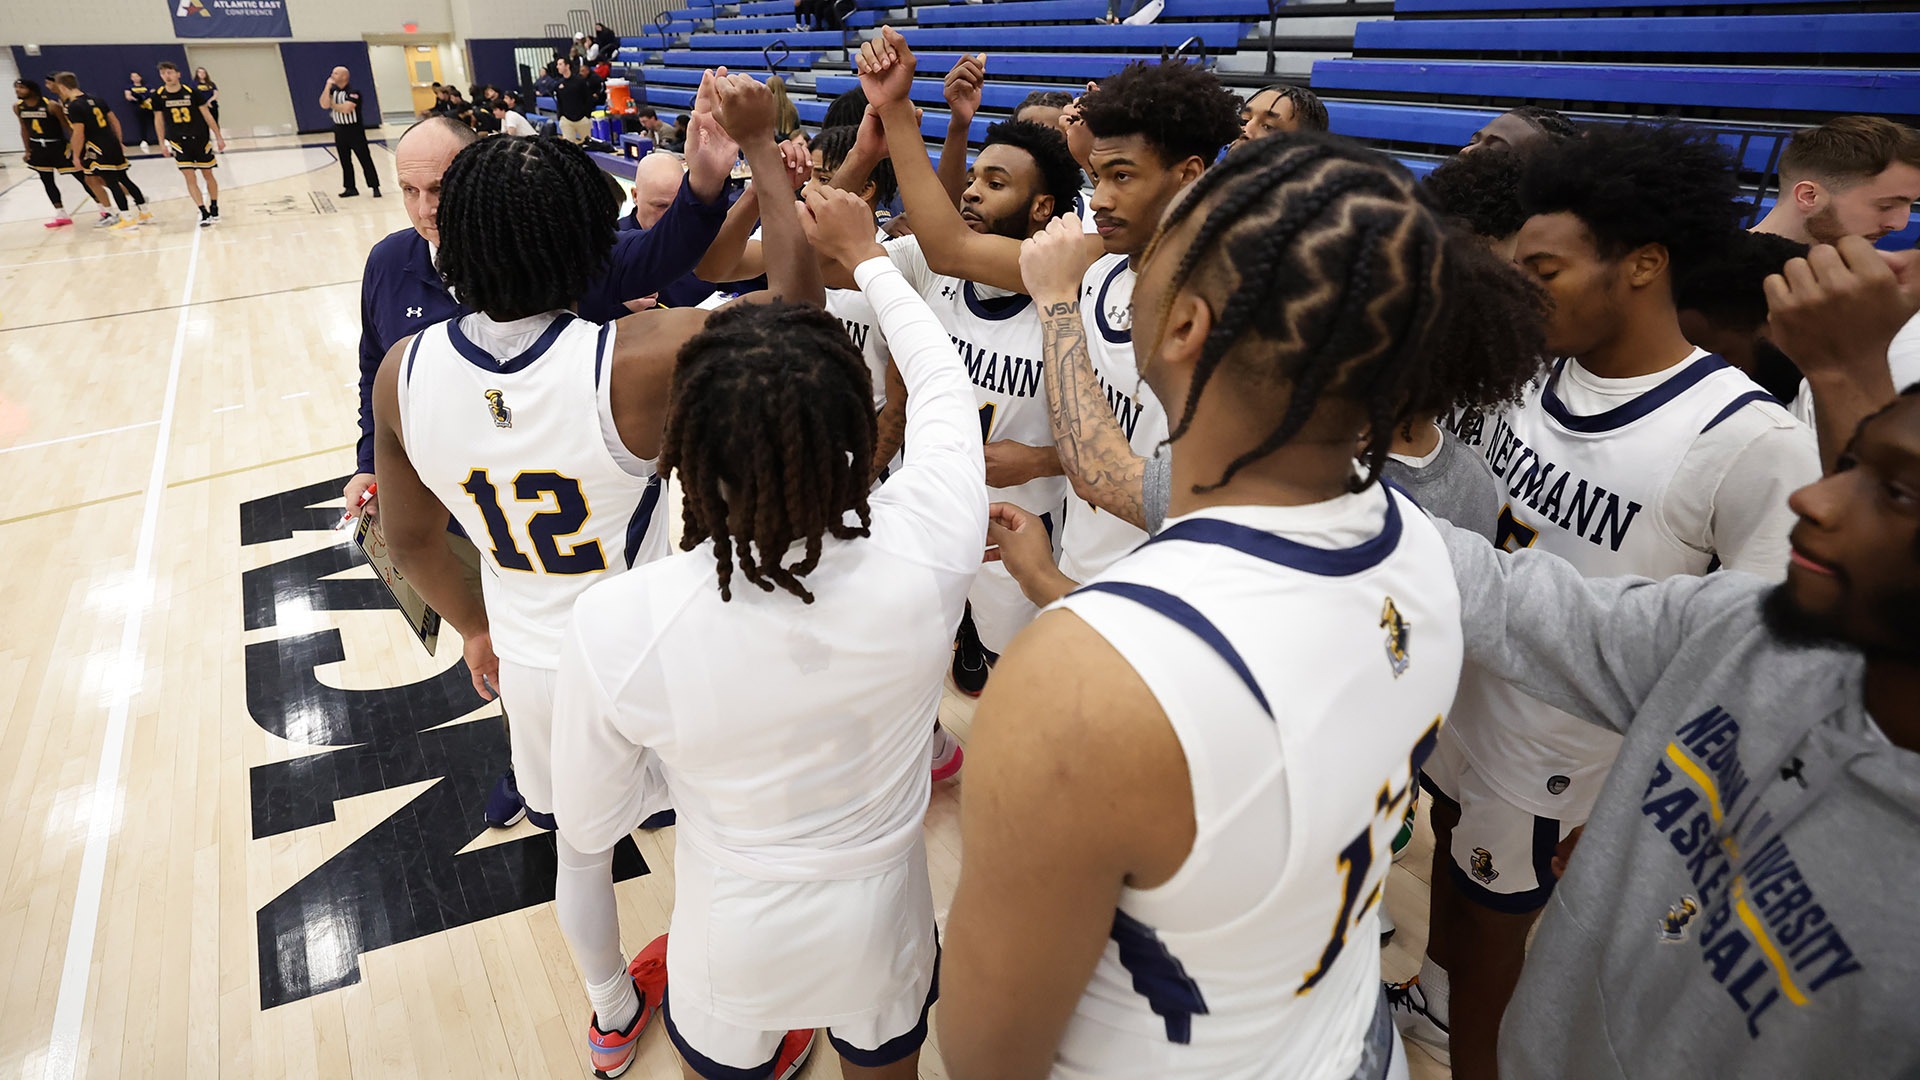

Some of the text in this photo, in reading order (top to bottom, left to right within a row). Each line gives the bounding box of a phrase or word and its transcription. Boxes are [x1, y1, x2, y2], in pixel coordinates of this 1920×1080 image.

[213, 0, 282, 9] ATLANTIC EAST
[225, 9, 274, 17] CONFERENCE
[170, 107, 192, 124] 23
[31, 118, 44, 134] 4
[948, 333, 1044, 398] MANN
[458, 467, 609, 576] 12
